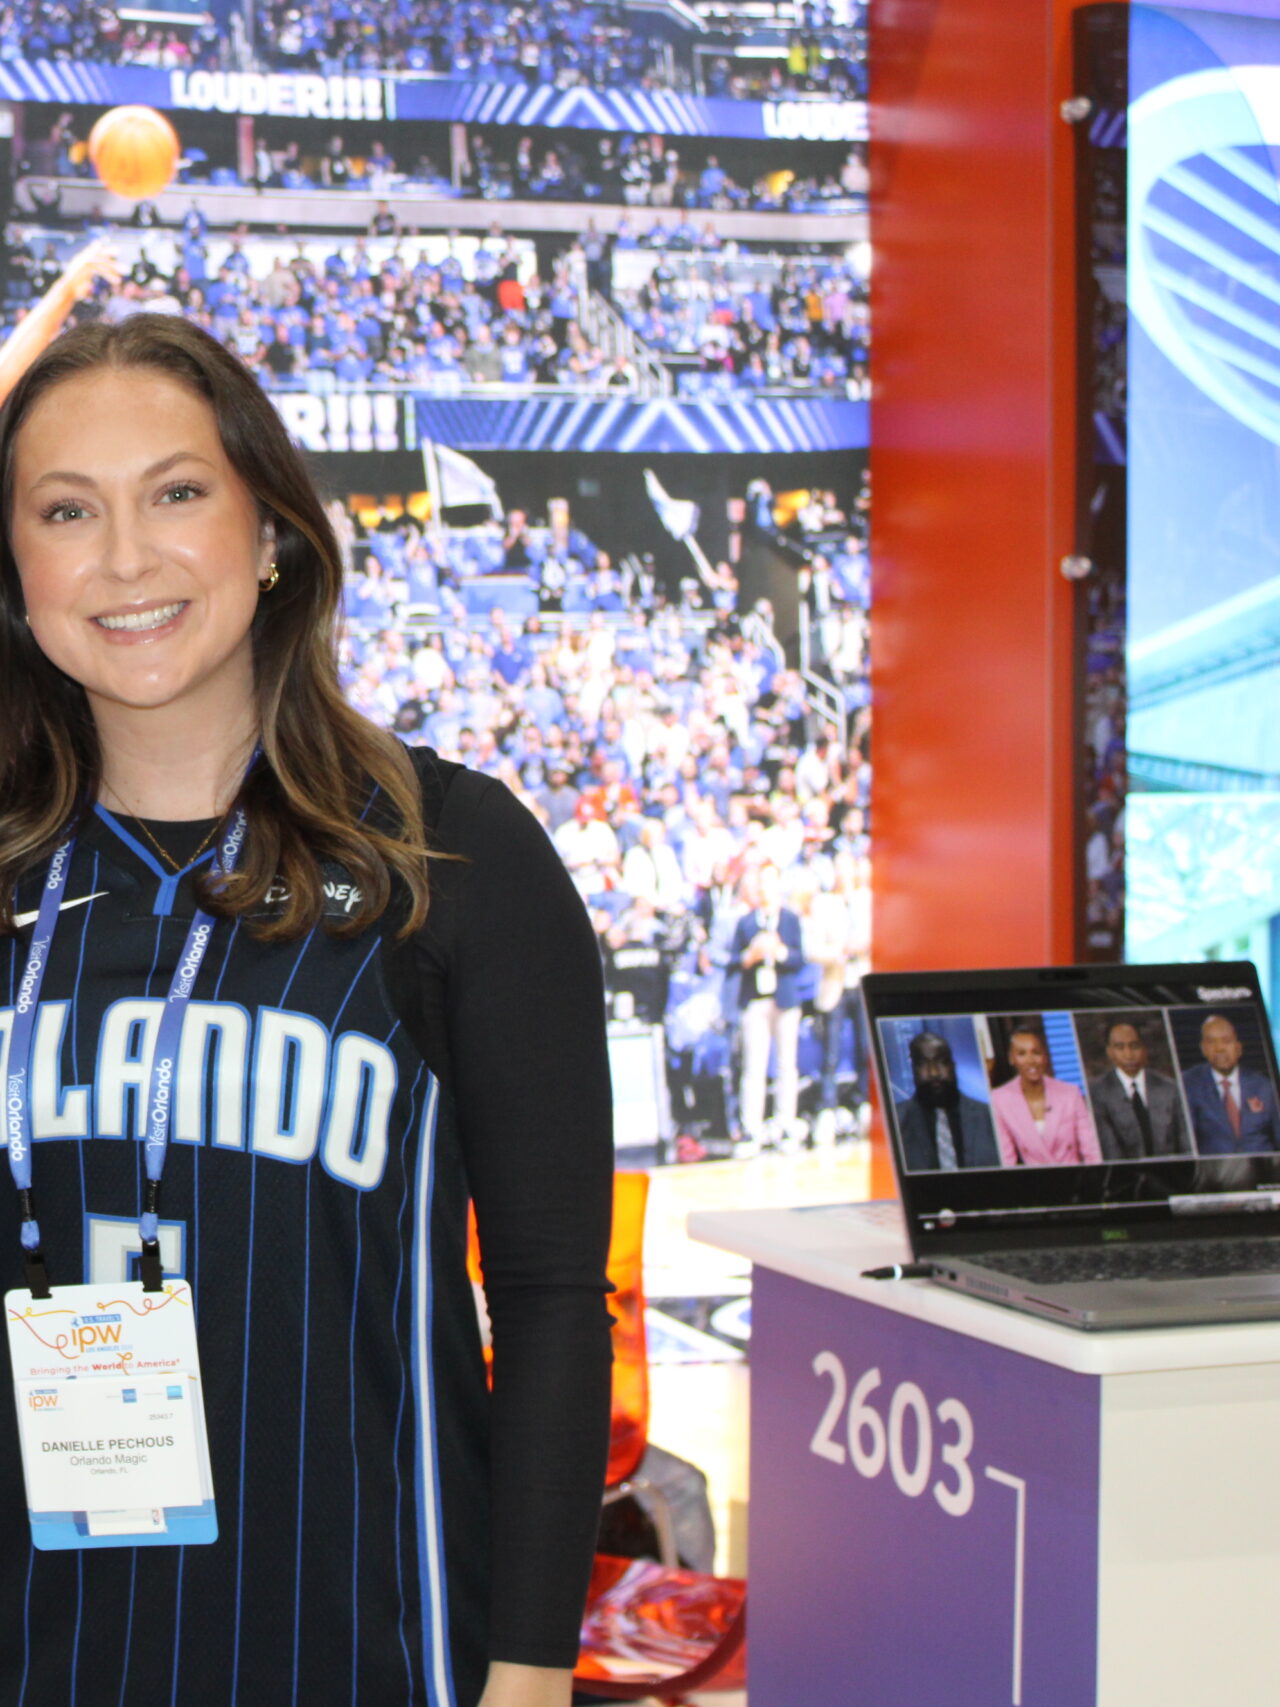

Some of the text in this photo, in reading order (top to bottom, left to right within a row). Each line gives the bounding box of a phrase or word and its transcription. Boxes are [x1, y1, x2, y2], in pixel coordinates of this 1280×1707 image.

[170, 70, 383, 121] LOUDER!!!
[72, 1324, 122, 1353] ipw
[92, 1362, 123, 1371] World
[42, 1436, 174, 1452] DANIELLE PECHOUS
[809, 1350, 974, 1517] 2603
[70, 1453, 147, 1466] Orlando Magic
